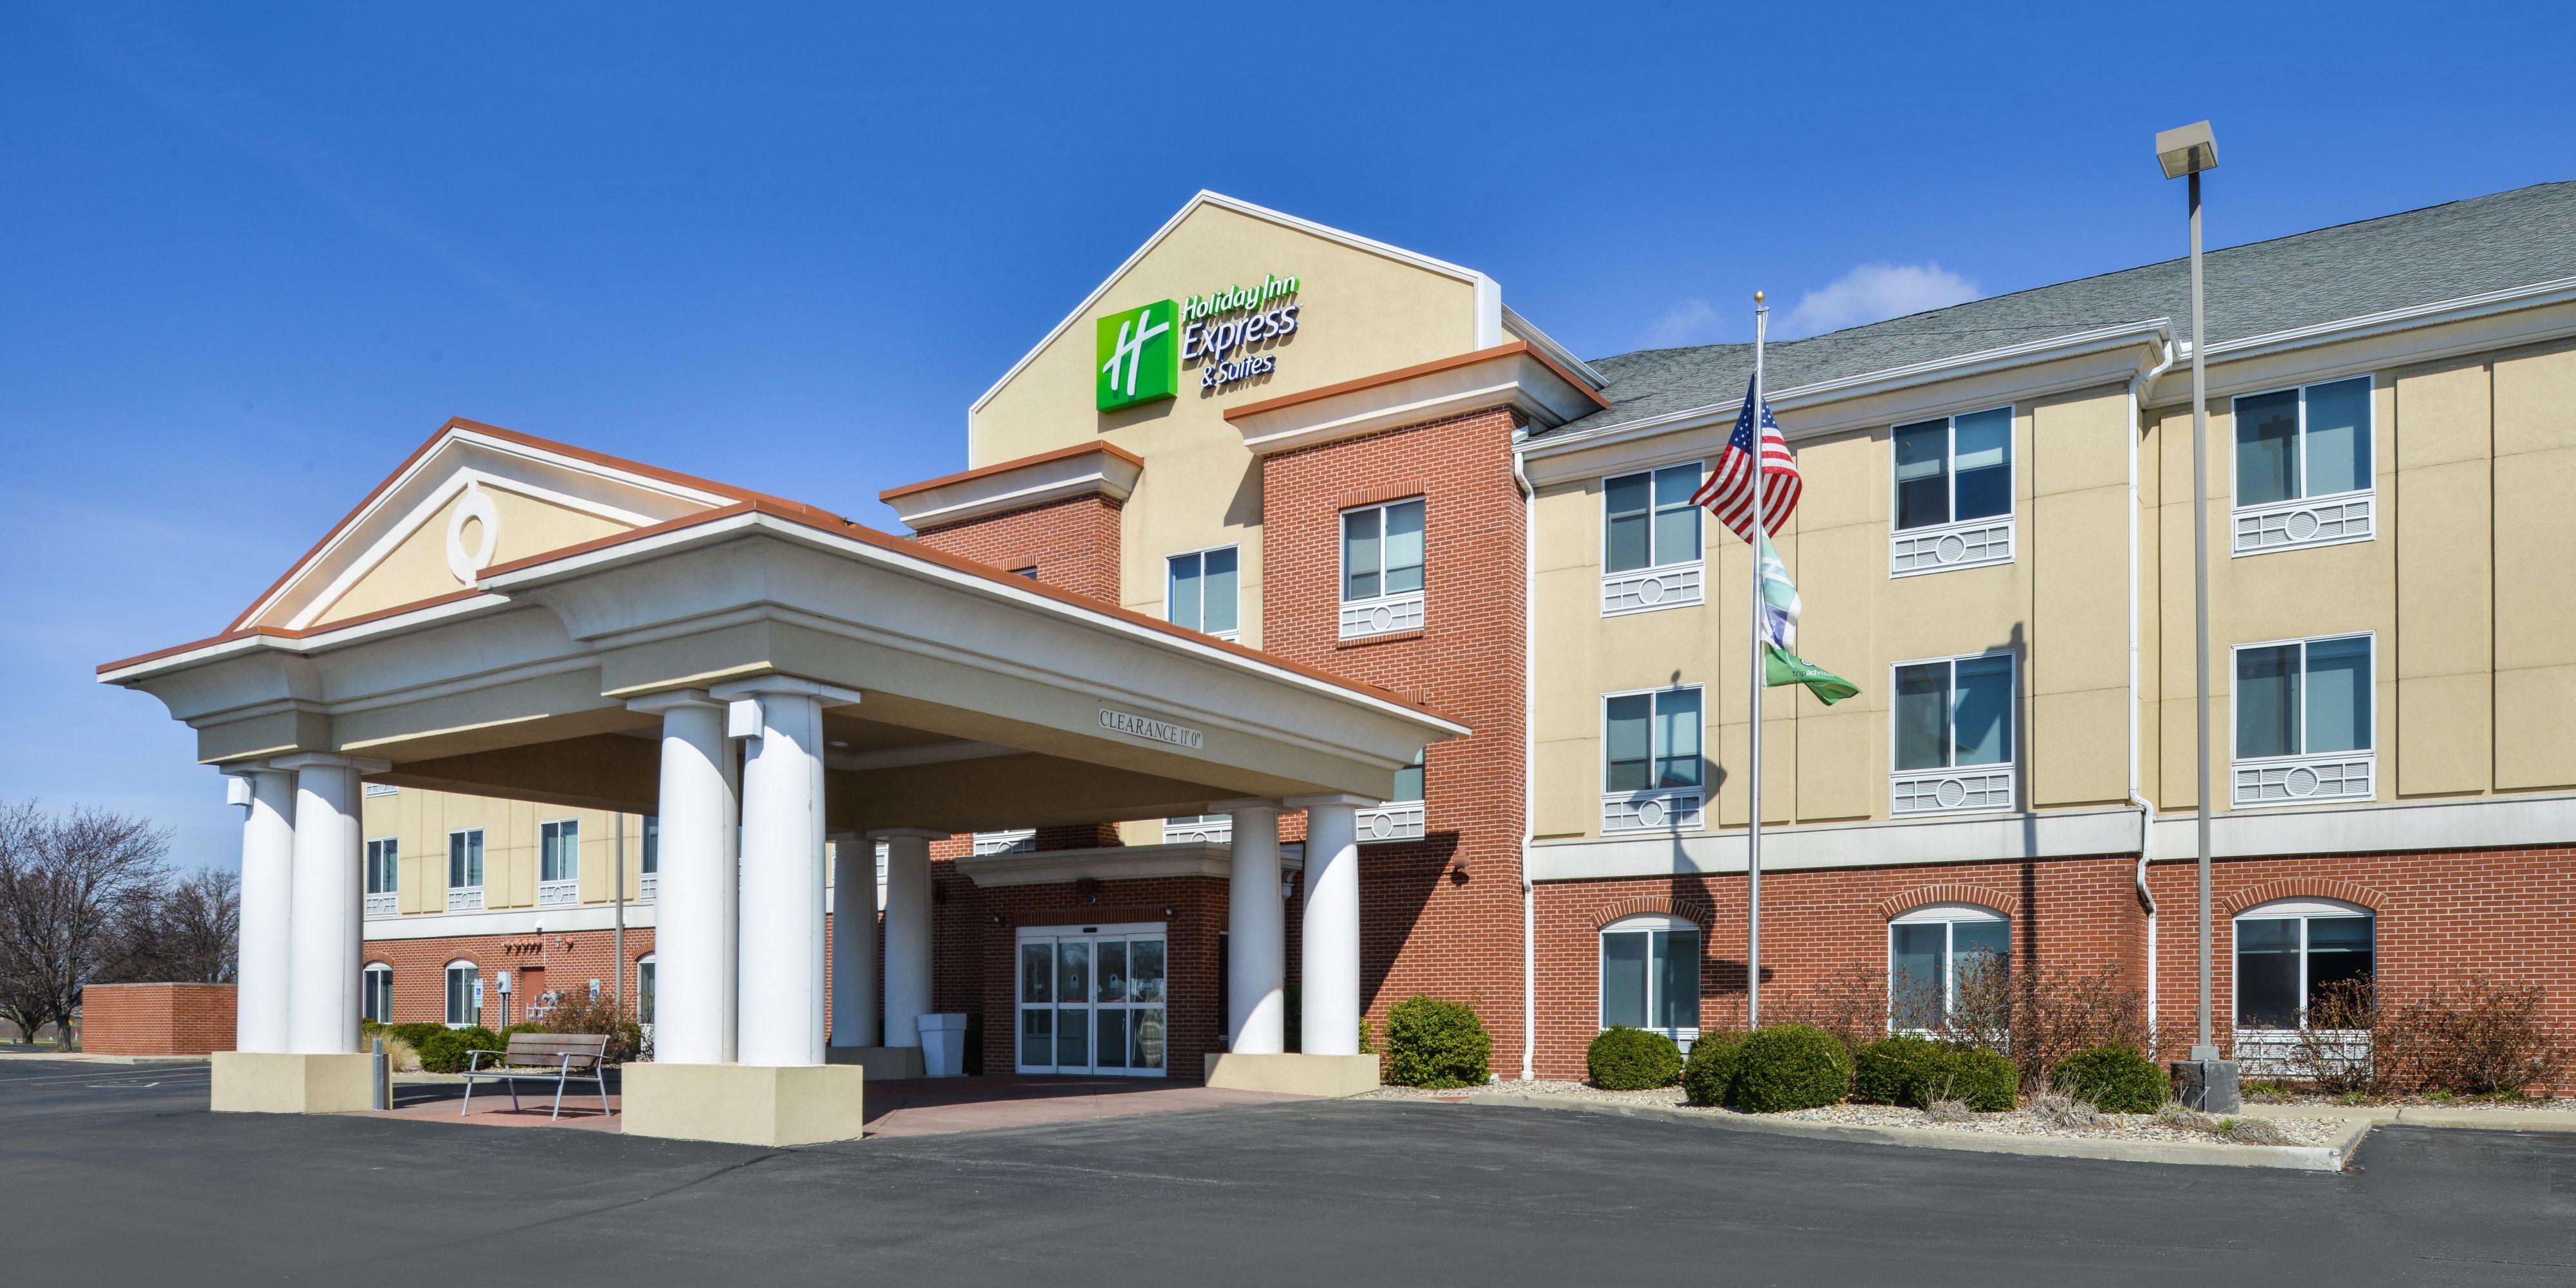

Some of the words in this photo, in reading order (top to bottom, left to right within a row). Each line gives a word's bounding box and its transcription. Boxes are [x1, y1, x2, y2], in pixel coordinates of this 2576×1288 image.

[1182, 284, 1264, 322] Holiday
[1263, 273, 1300, 301] Inn
[1182, 305, 1300, 361] Express
[1200, 365, 1217, 389] &
[1217, 354, 1277, 385] Suites
[1100, 710, 1177, 742] CLEARANCE
